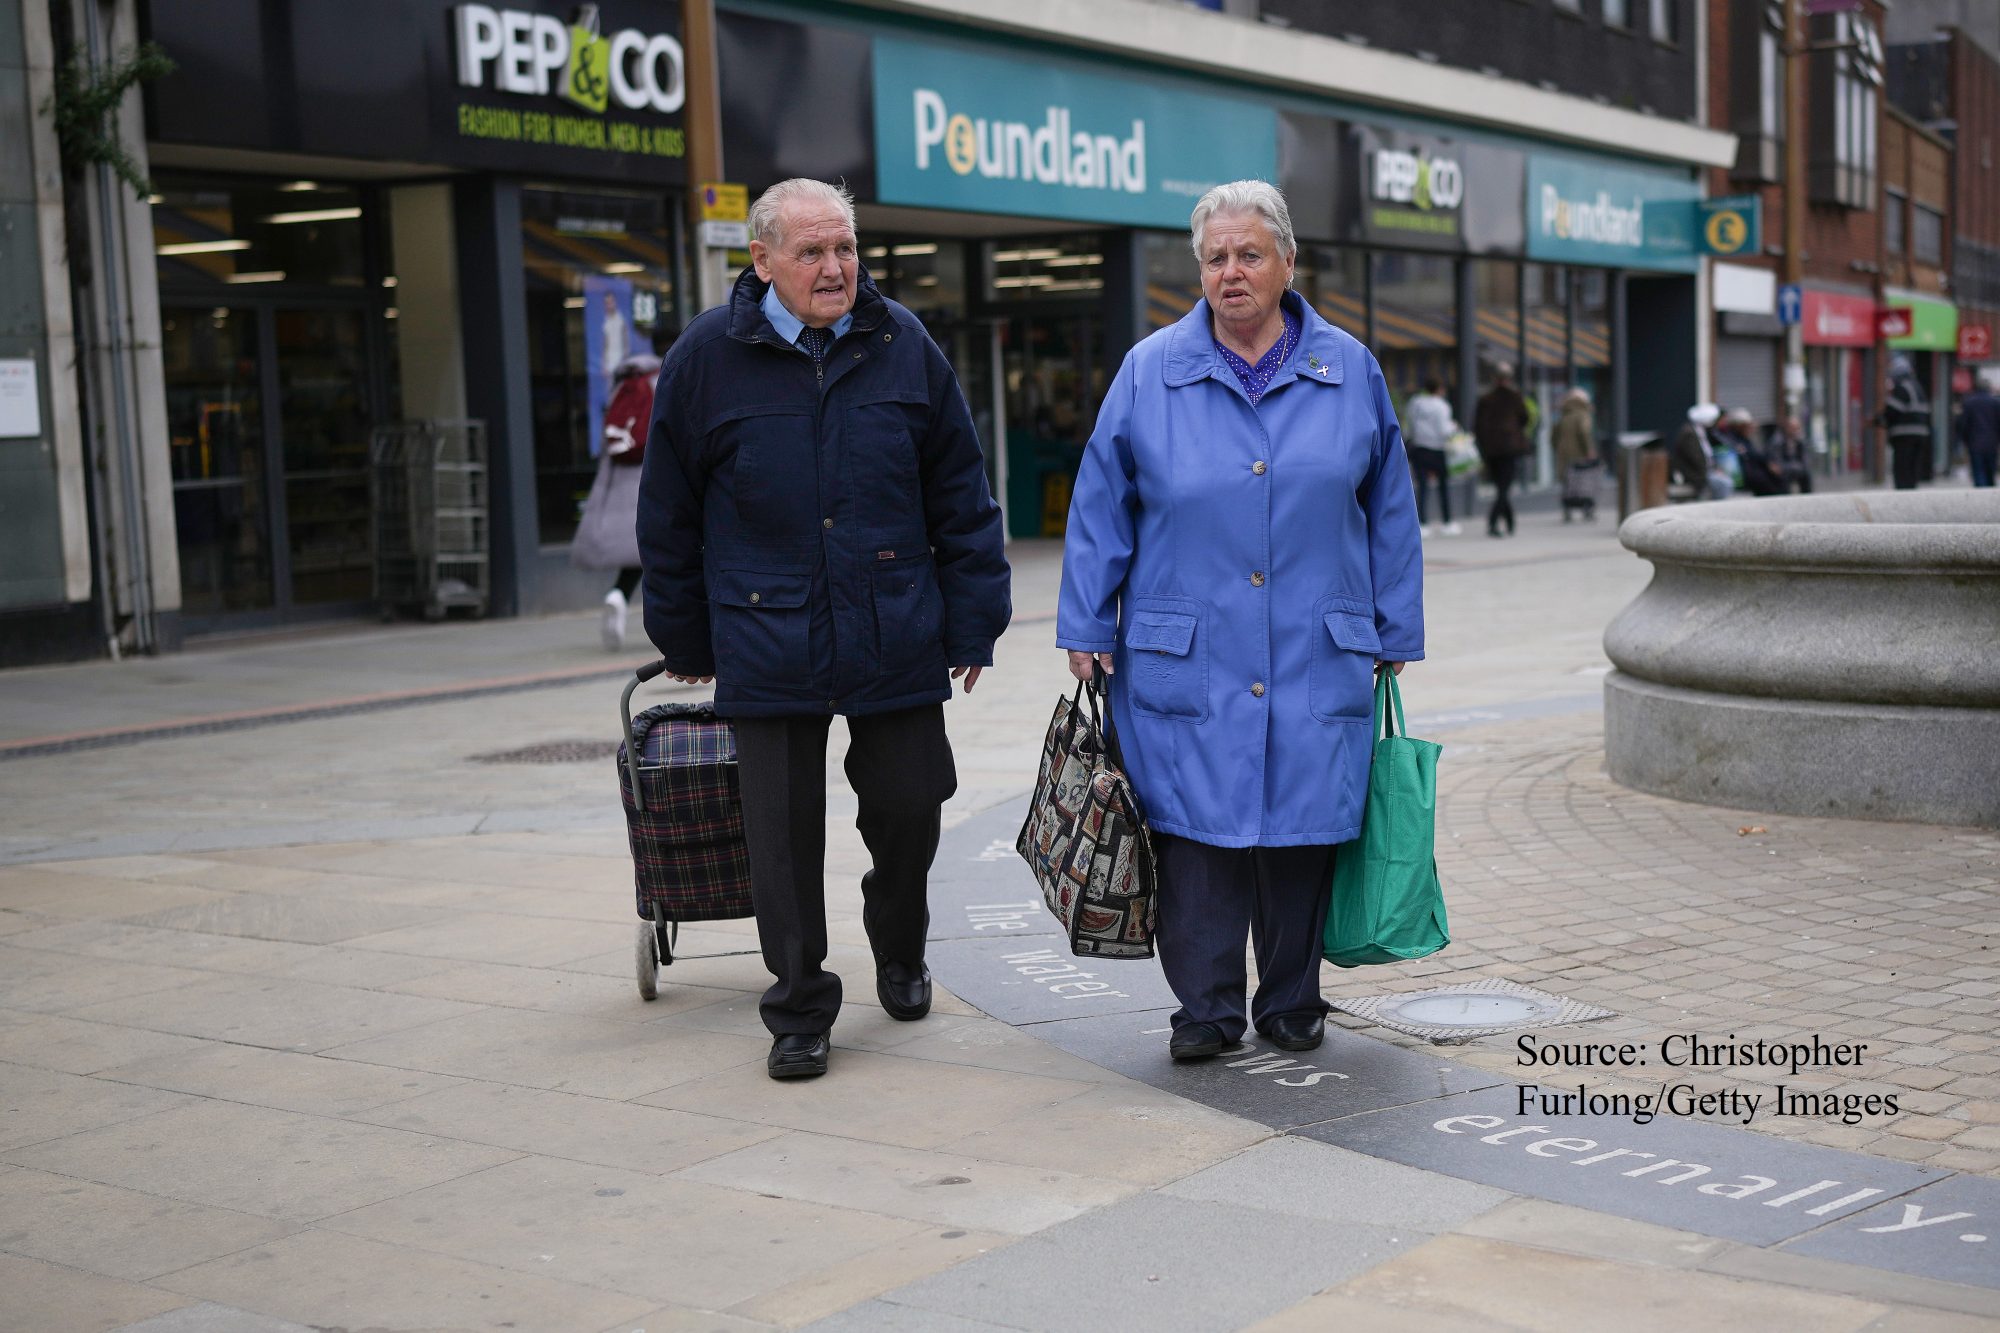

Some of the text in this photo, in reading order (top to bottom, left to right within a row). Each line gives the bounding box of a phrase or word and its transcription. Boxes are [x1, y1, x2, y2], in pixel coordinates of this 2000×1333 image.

[458, 103, 521, 140] FASHION
[523, 111, 551, 143] FOR
[609, 122, 640, 152] MEN
[653, 127, 685, 158] KIDS
[913, 88, 1147, 193] Poundland
[1540, 184, 1644, 247] Poundland
[965, 900, 1041, 930] The
[1000, 949, 1130, 999] water
